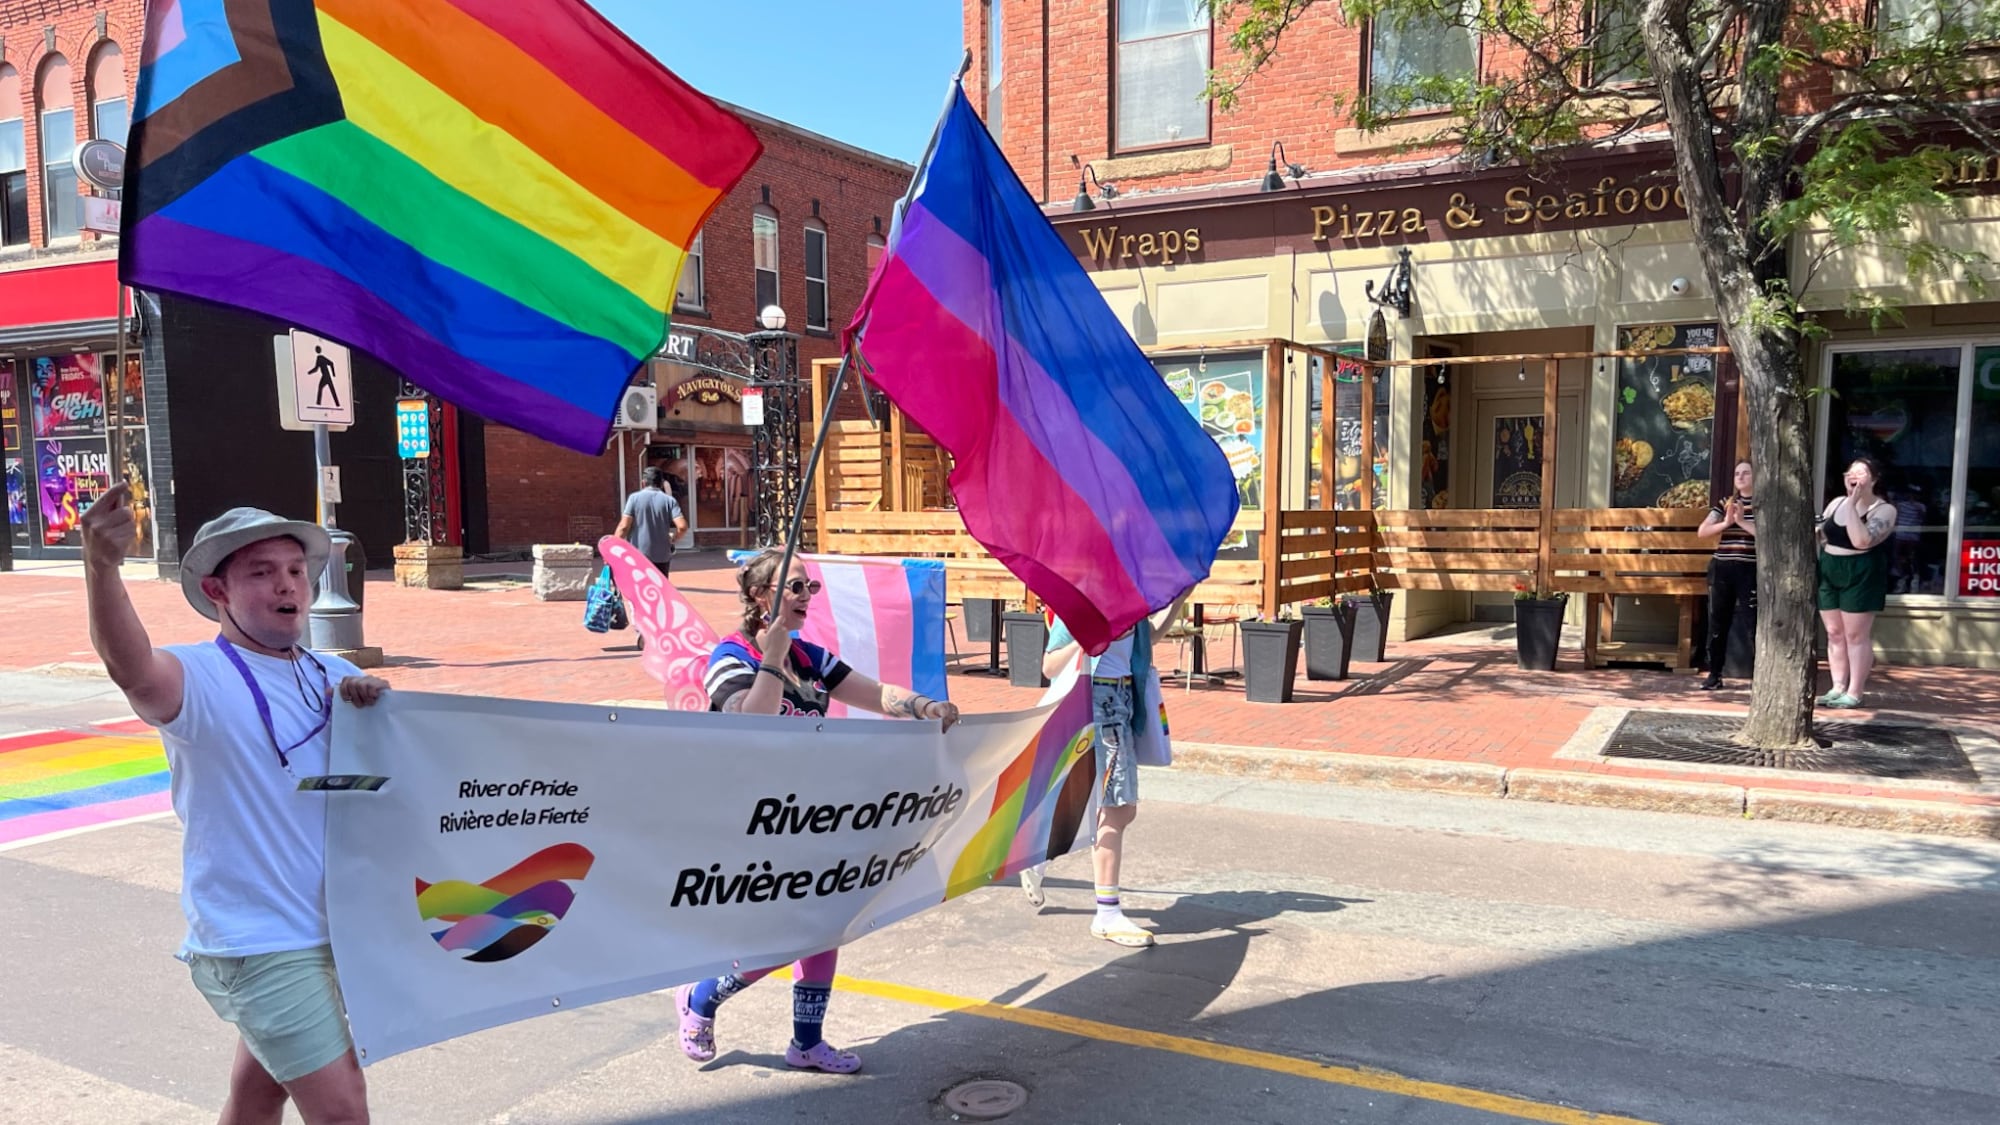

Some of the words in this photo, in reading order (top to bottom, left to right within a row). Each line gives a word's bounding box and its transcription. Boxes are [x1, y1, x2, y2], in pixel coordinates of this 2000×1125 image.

[1311, 203, 1427, 242] Pizza
[1445, 191, 1484, 230] &
[1079, 226, 1201, 265] Wraps
[677, 378, 742, 403] NAVIGATORS
[57, 453, 108, 477] SPLASH
[458, 779, 507, 798] River
[507, 779, 531, 796] of
[530, 780, 579, 796] Pride
[440, 809, 494, 833] Rivière
[495, 809, 519, 827] de
[520, 808, 537, 826] la
[538, 806, 590, 825] Fierté
[746, 793, 854, 835] River
[851, 791, 900, 831] of
[891, 782, 963, 827] Pride
[670, 860, 813, 907] Rivière
[814, 859, 861, 897] de
[859, 853, 888, 889] la
[886, 841, 927, 881] Fie
